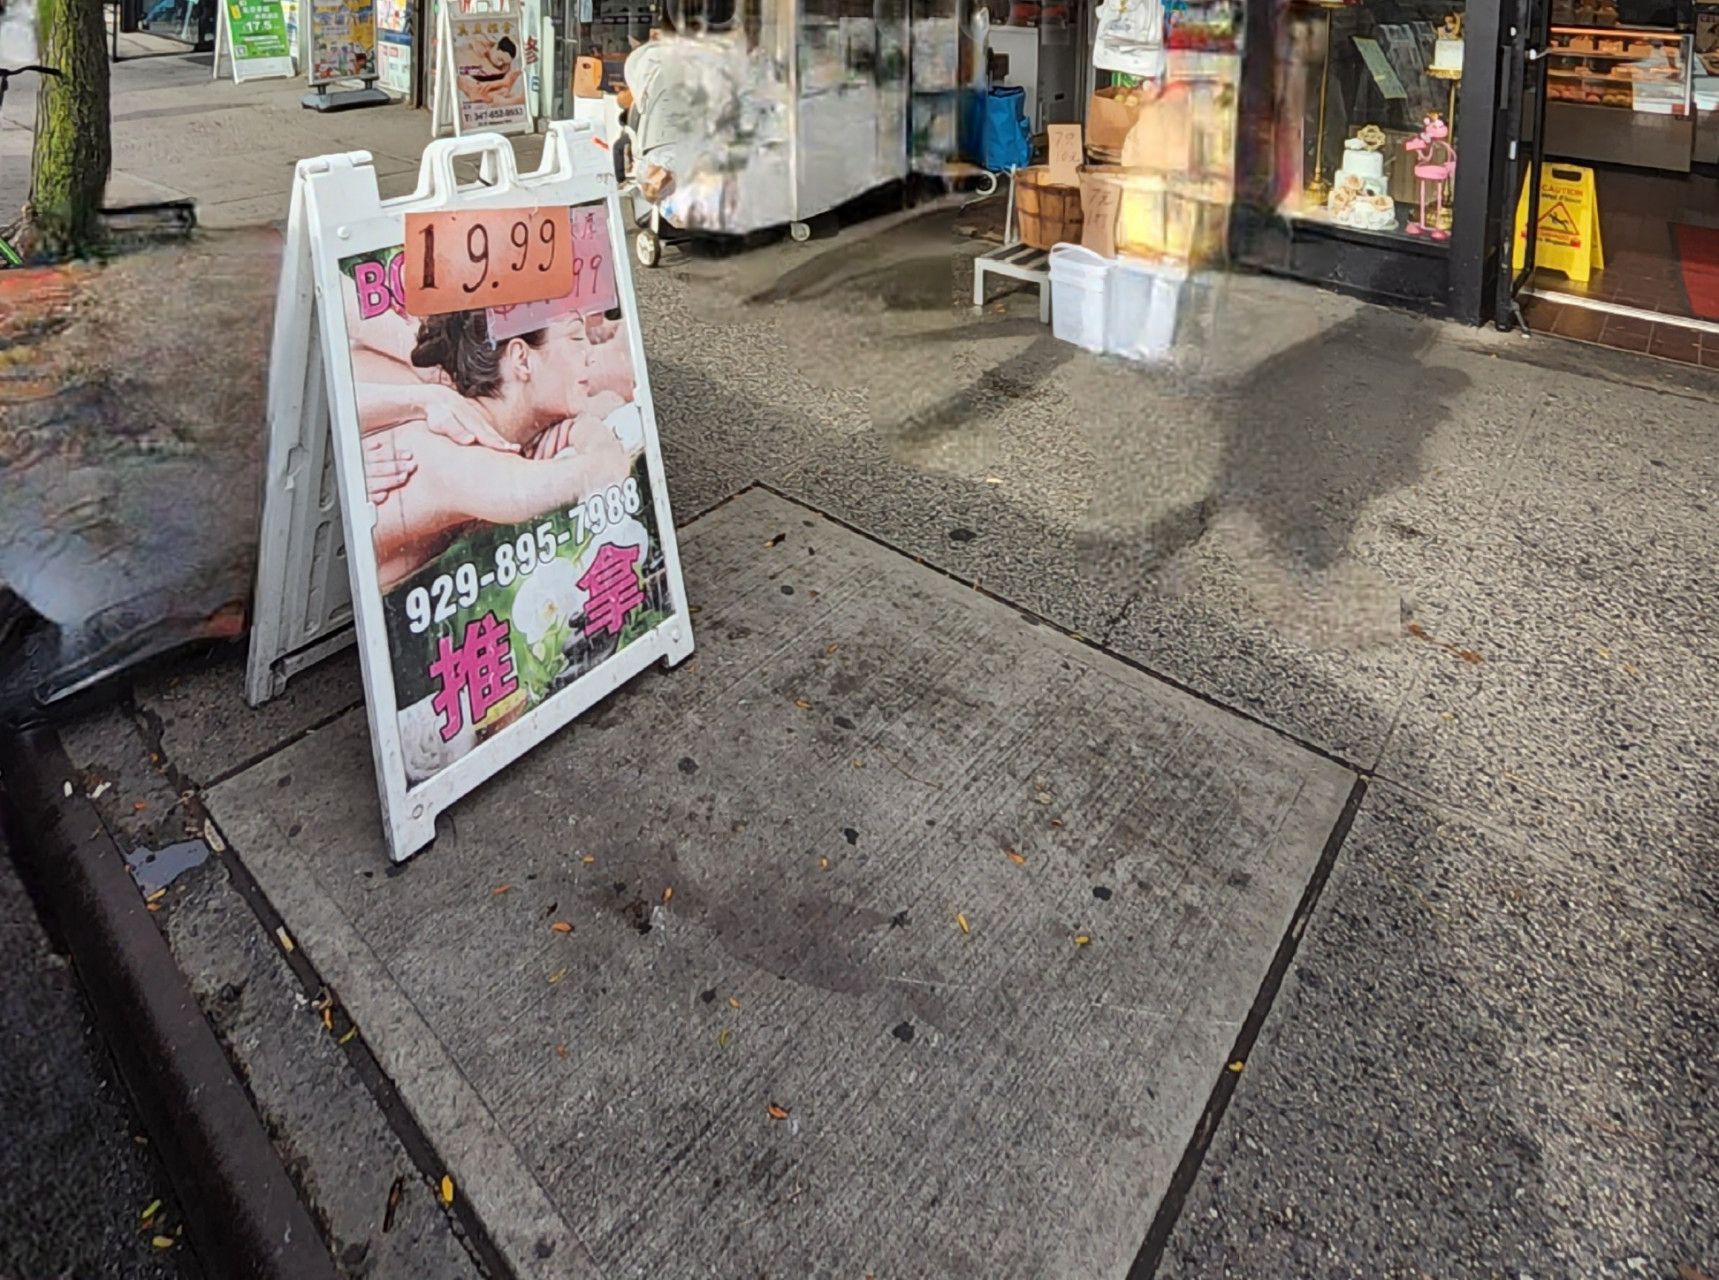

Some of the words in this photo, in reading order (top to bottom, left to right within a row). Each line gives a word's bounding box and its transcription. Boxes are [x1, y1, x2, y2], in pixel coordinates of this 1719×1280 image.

[417, 217, 557, 294] 19.99
[404, 475, 642, 635] 929-895-7988
[426, 539, 647, 744] 推拿
